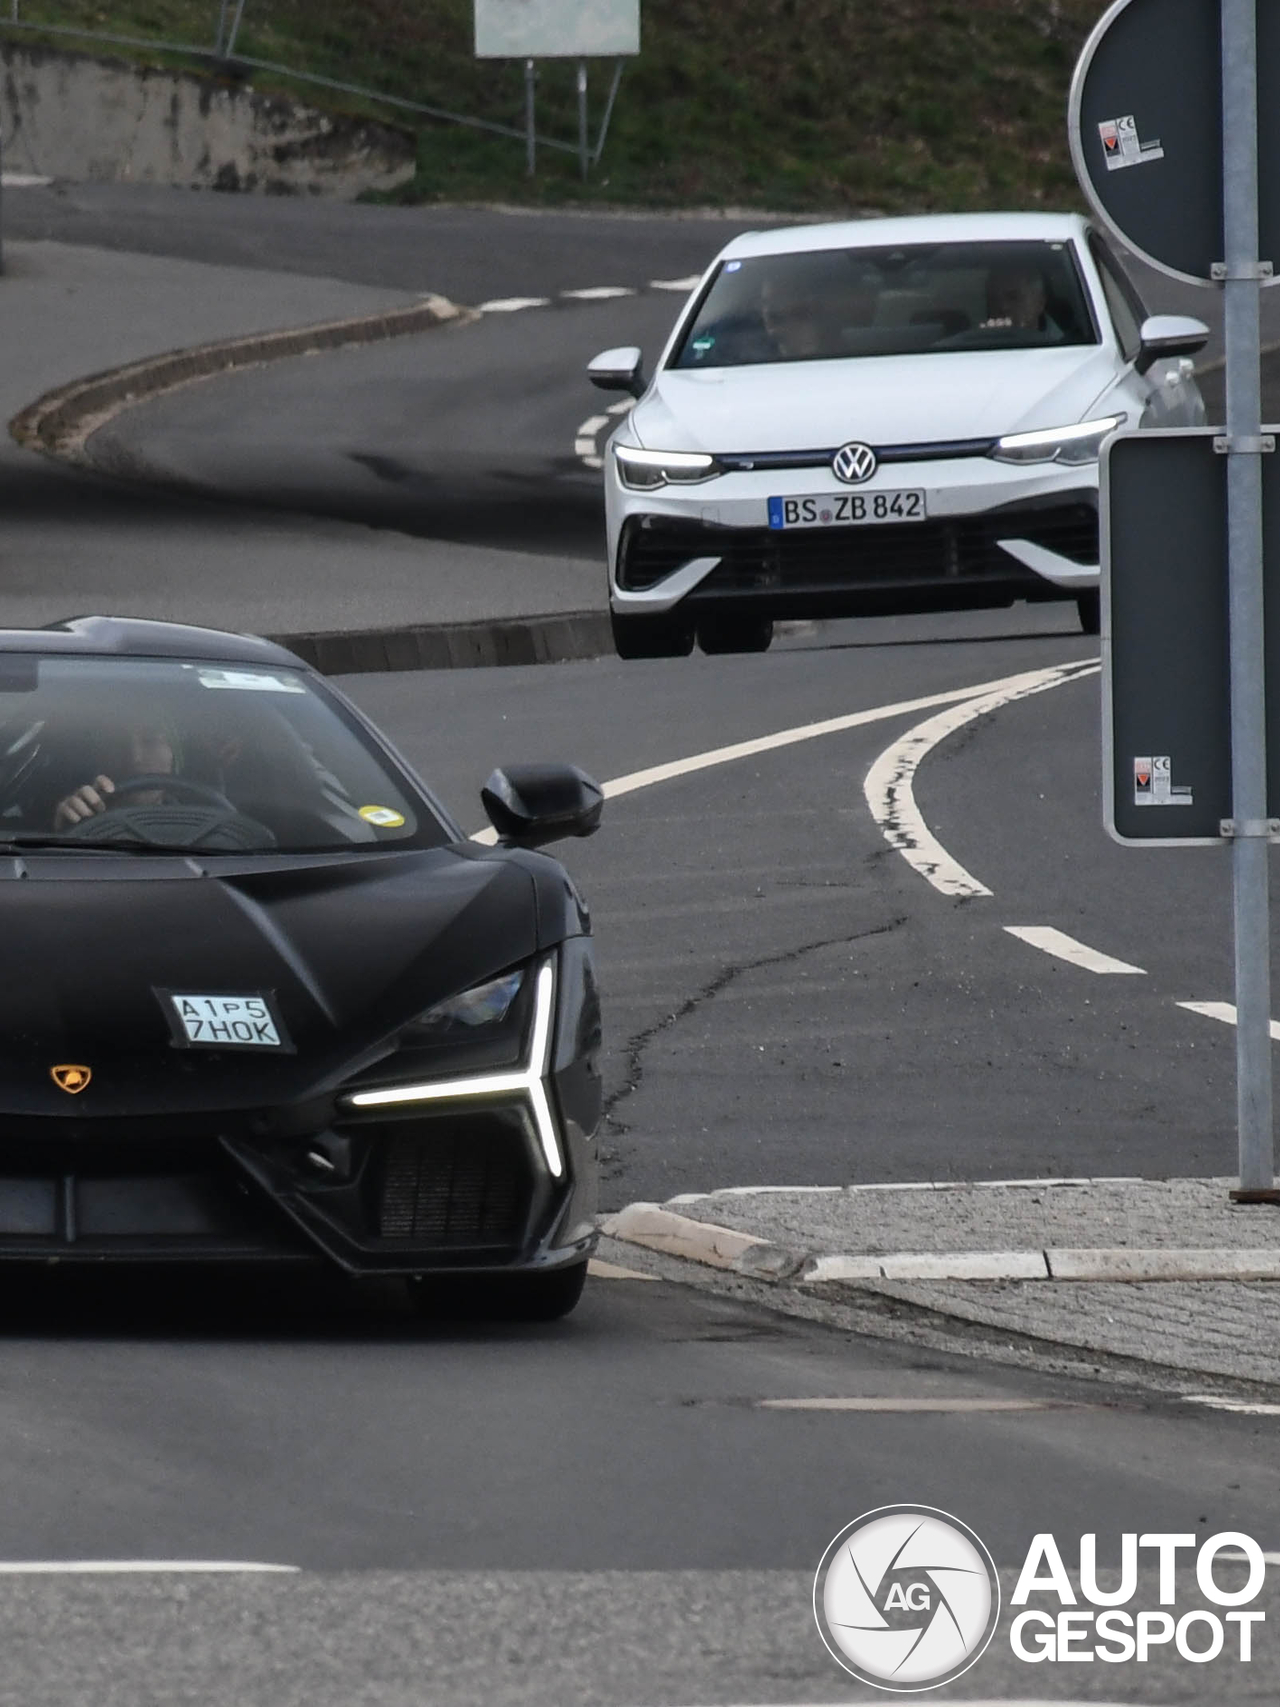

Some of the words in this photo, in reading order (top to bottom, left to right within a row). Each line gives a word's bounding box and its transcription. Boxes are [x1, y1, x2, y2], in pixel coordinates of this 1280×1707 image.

[1118, 117, 1135, 131] CE
[785, 499, 817, 524] BS
[834, 496, 867, 521] ZB
[873, 493, 920, 518] 842
[1154, 758, 1170, 770] CE
